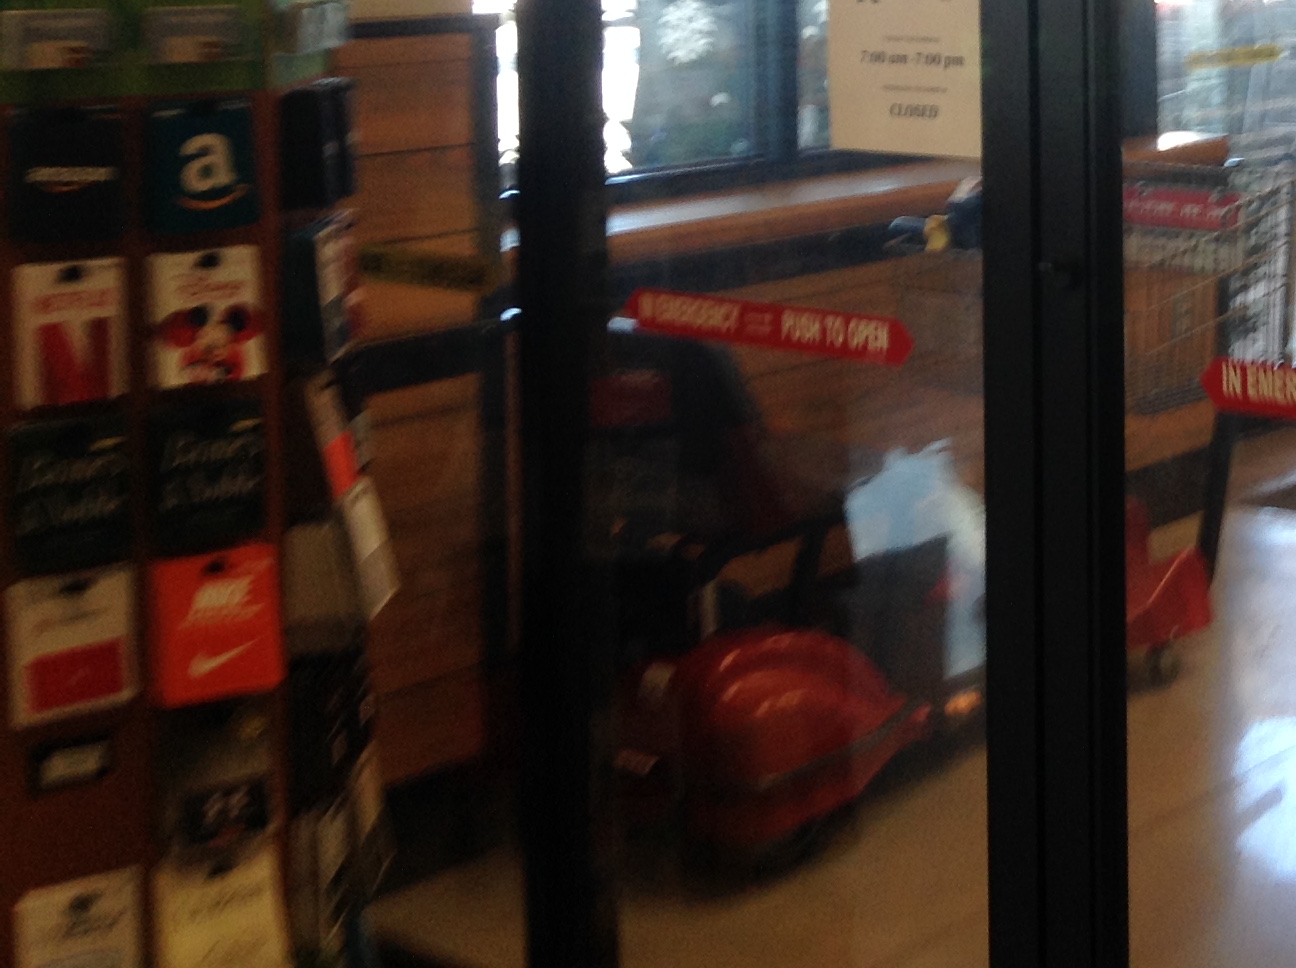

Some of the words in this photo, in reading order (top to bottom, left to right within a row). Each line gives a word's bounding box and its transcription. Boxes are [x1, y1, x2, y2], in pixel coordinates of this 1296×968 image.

[781, 309, 821, 344] PUSH
[824, 314, 846, 349] TO
[848, 317, 889, 353] OPEN
[1222, 361, 1242, 399] IN
